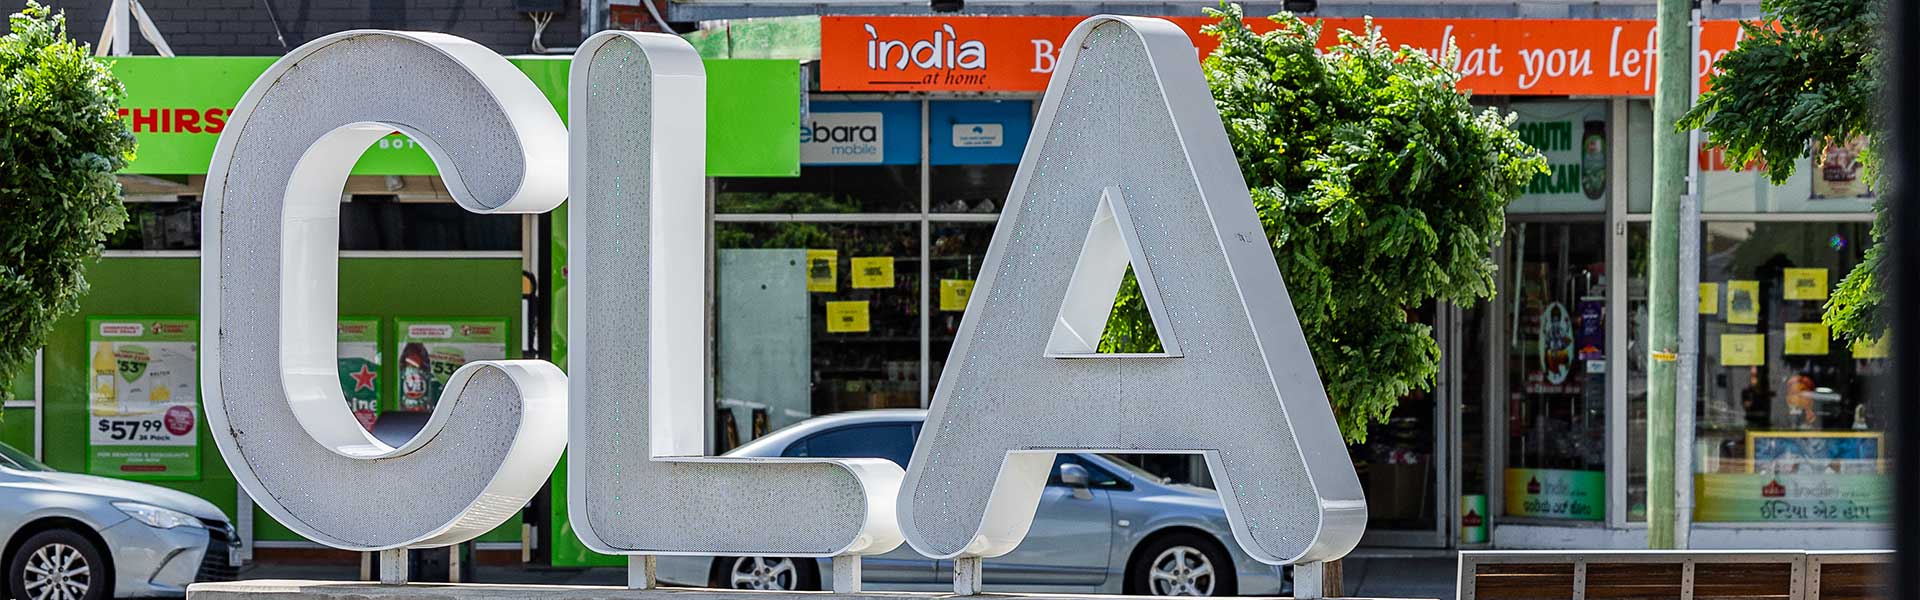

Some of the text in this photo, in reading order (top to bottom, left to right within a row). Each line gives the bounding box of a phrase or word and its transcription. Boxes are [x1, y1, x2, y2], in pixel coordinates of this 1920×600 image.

[864, 23, 986, 70] india
[1518, 48, 1594, 90] you
[1608, 26, 1660, 91] lef
[922, 70, 987, 86] at home
[118, 107, 234, 134] HIRS
[800, 121, 877, 143] ebara
[831, 144, 877, 155] mobile
[1520, 164, 1580, 194] RICAN
[202, 15, 1367, 563] CLA
